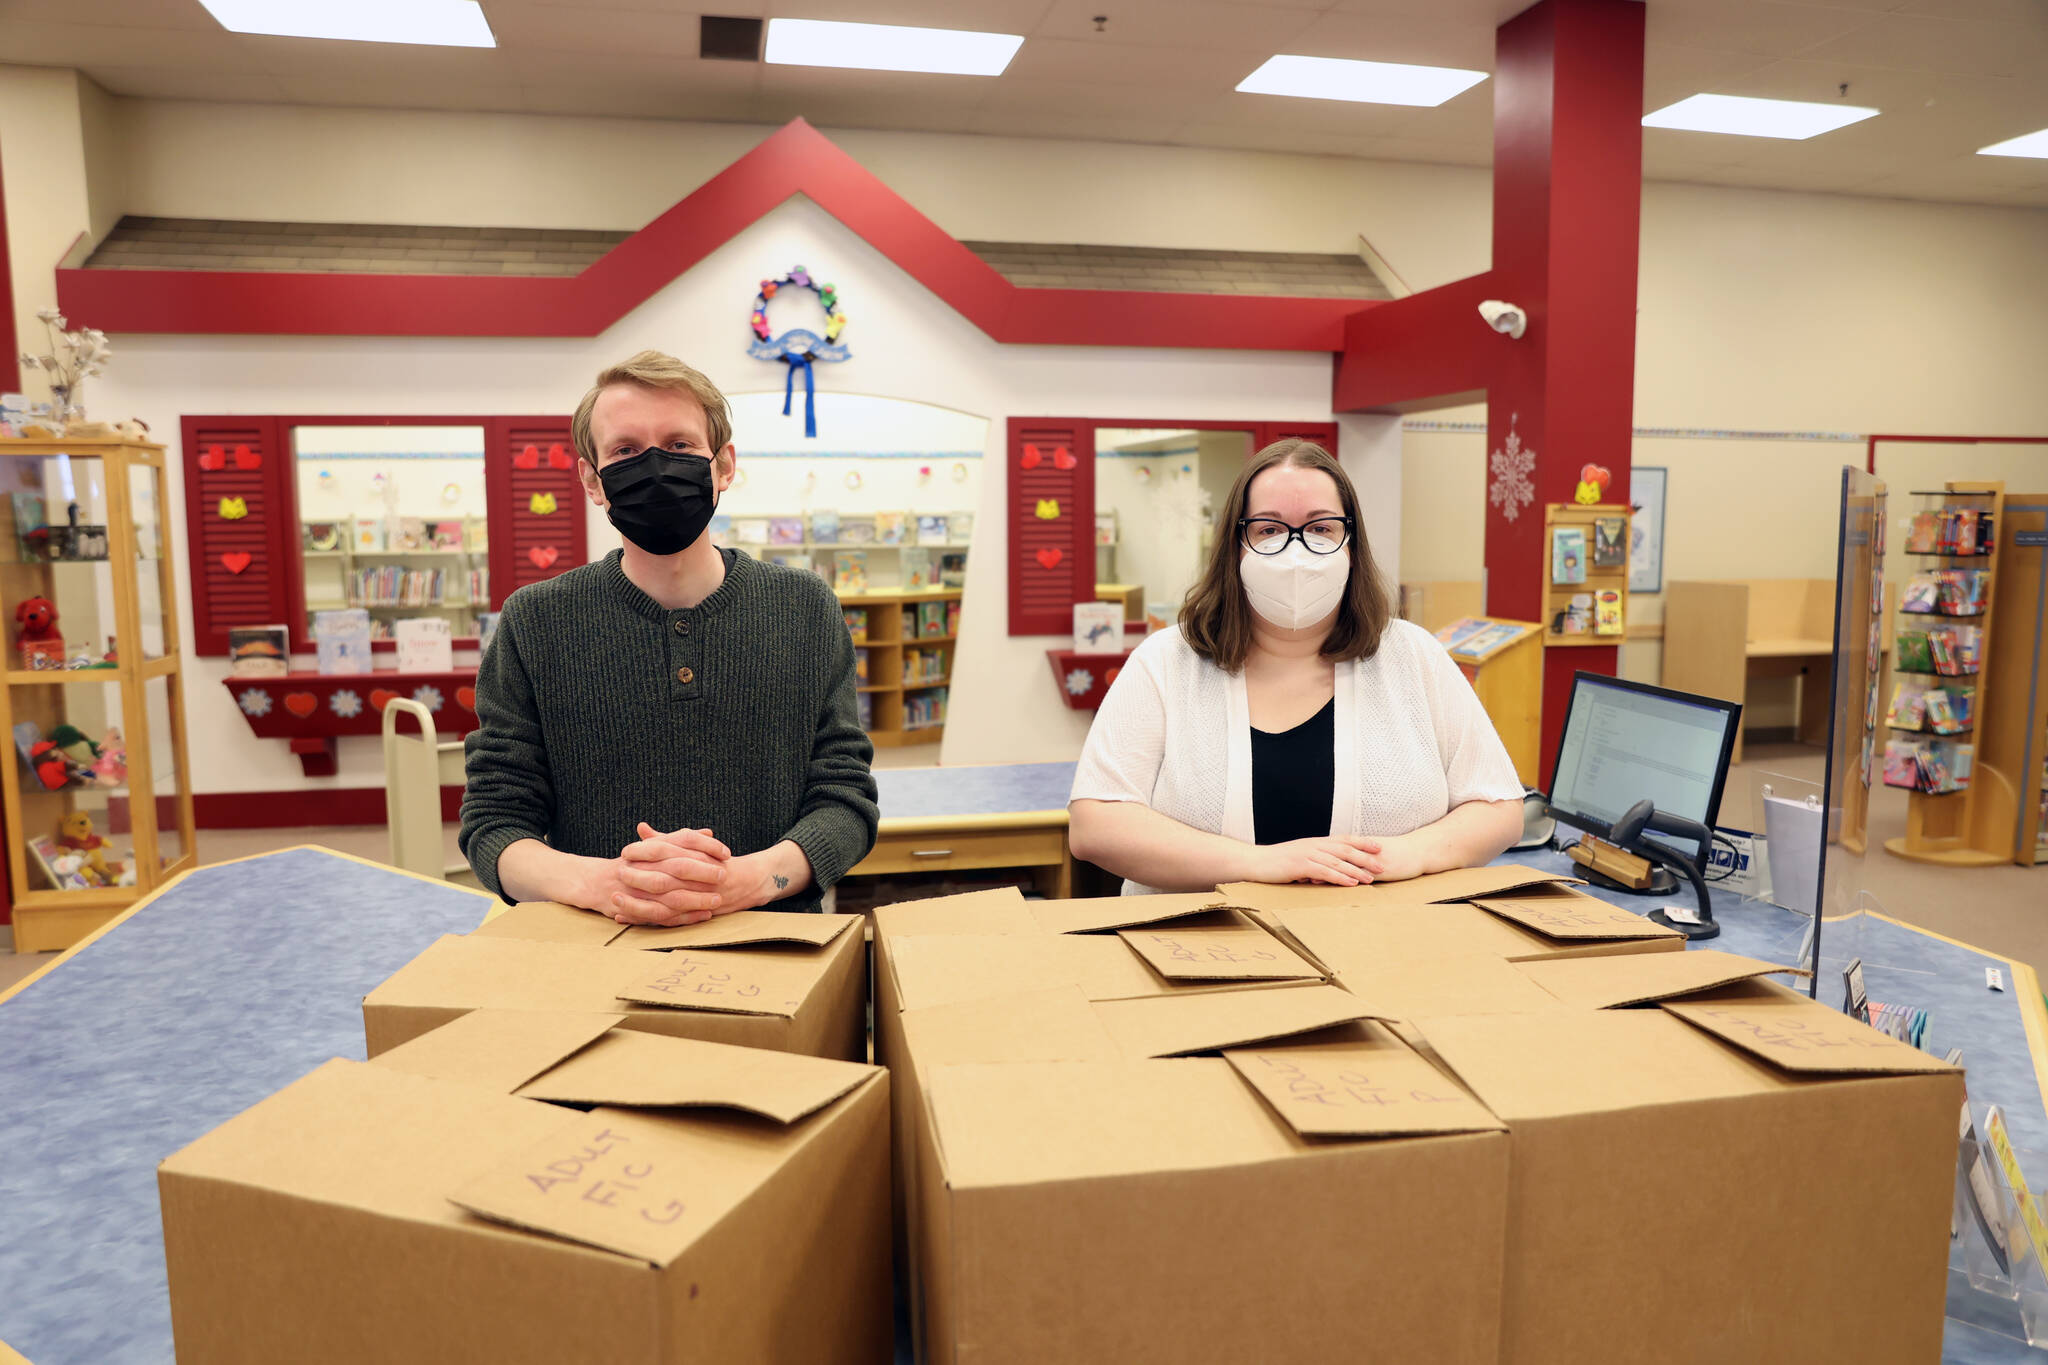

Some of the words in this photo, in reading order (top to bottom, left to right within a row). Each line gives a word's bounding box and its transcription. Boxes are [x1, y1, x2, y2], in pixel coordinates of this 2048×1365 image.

[645, 957, 709, 994] ADULT
[692, 973, 732, 994] FIC
[525, 1128, 631, 1194] ADULT
[581, 1163, 653, 1208] FIC
[639, 1199, 686, 1225] G
